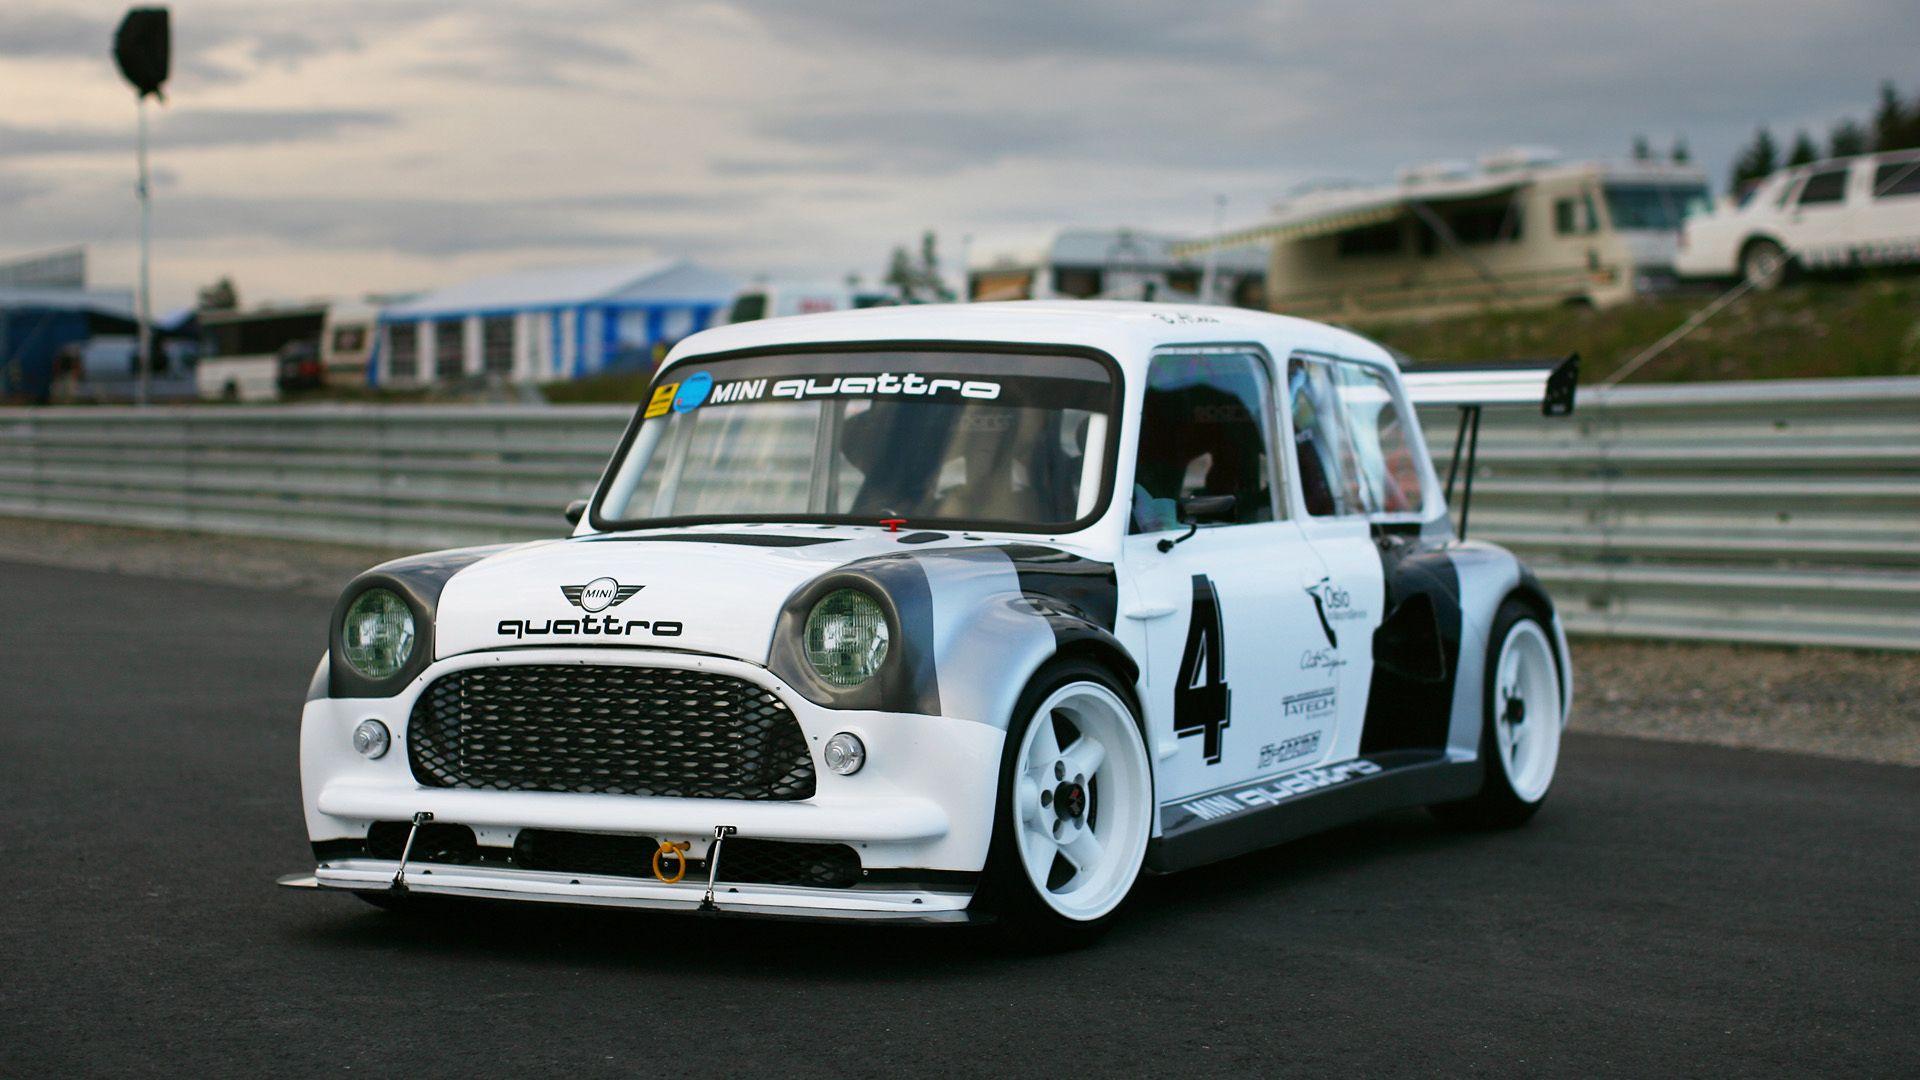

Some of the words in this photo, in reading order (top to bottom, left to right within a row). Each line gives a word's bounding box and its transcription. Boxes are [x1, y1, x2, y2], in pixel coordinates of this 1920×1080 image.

[710, 379, 767, 404] MINI
[772, 373, 1001, 400] quattro
[585, 589, 613, 599] MINI
[1324, 586, 1350, 608] Oslo
[497, 614, 683, 639] quattro
[1173, 574, 1232, 766] 4
[1182, 794, 1245, 821] MINI
[1234, 760, 1383, 806] quattro
